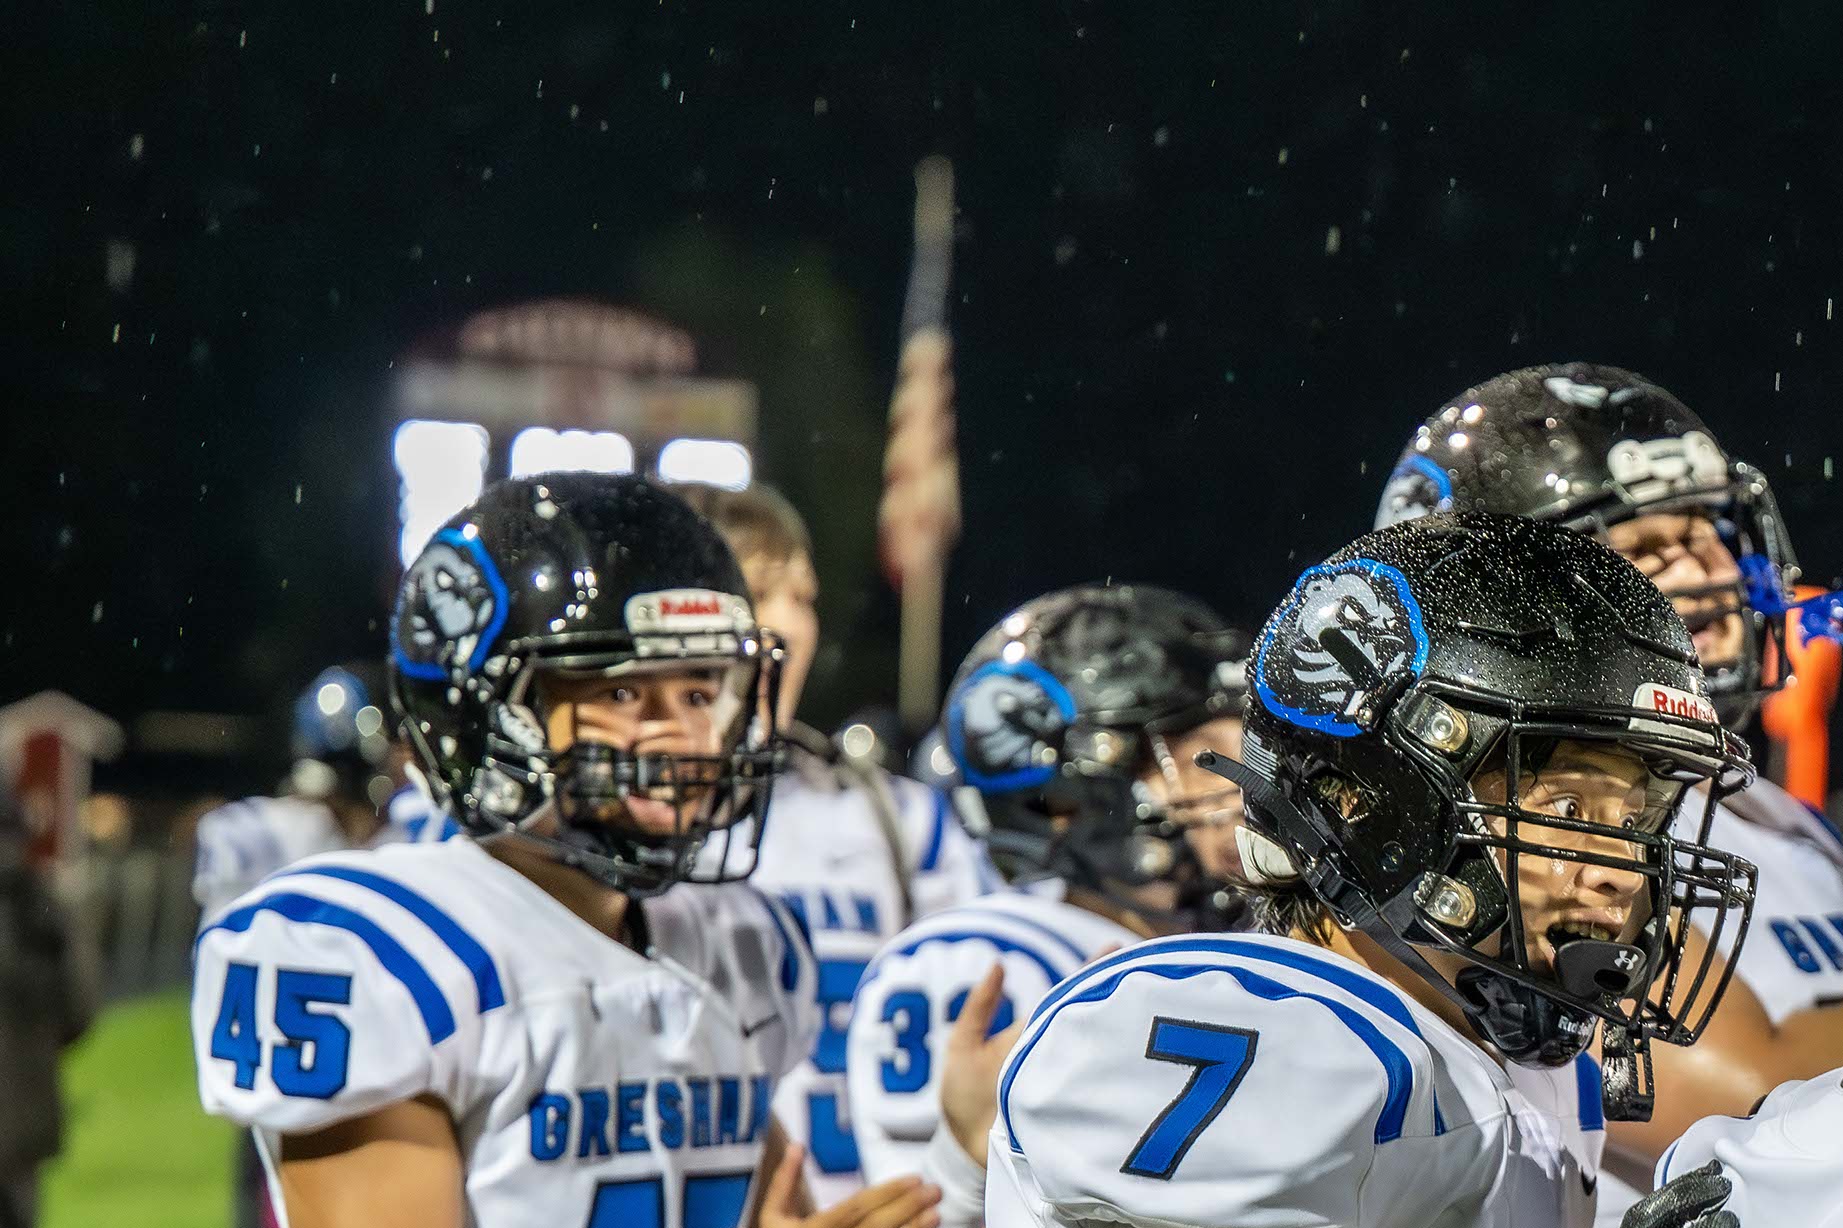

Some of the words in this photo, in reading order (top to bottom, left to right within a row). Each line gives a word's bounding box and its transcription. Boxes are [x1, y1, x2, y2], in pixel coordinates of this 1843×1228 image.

[1653, 689, 1715, 721] Ridd
[210, 962, 352, 1099] 45
[1119, 1016, 1260, 1180] 7
